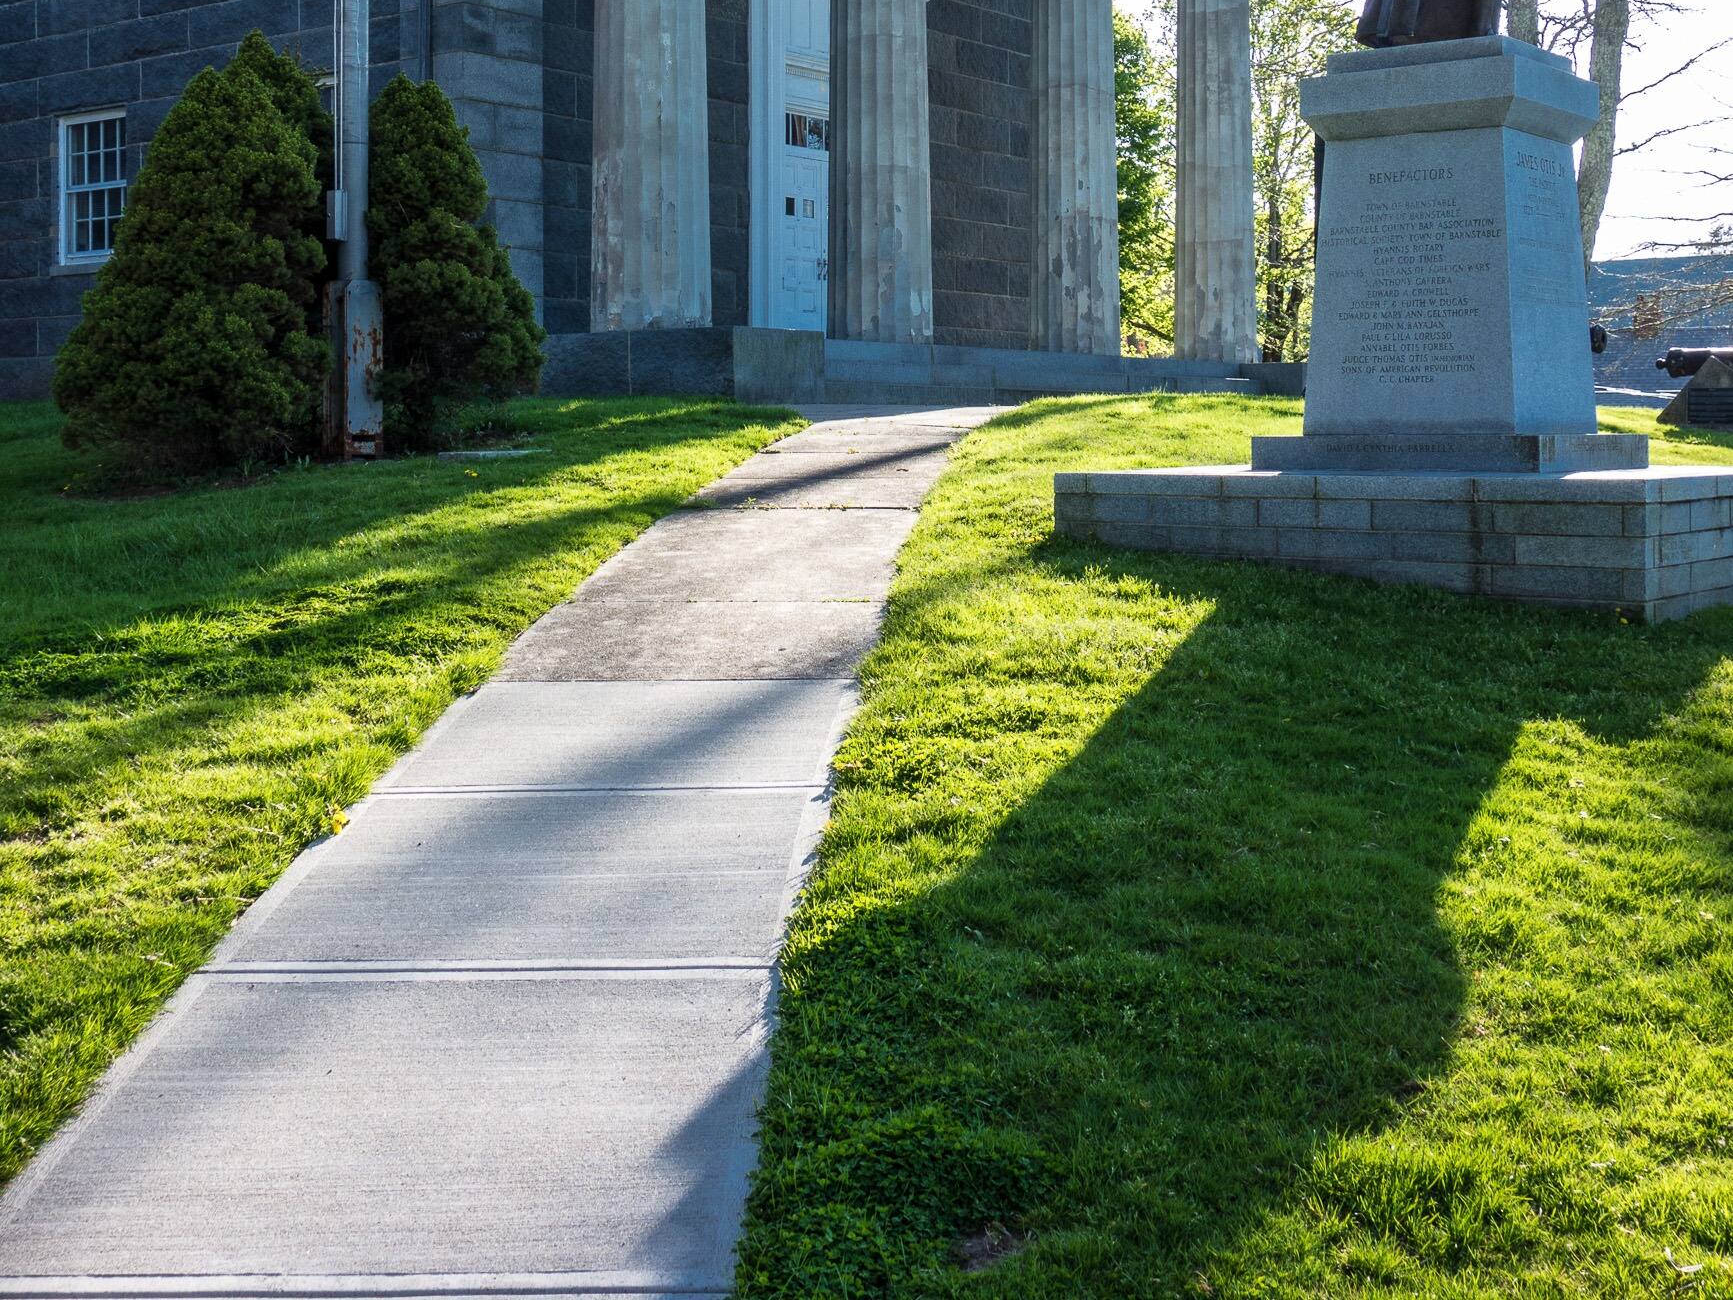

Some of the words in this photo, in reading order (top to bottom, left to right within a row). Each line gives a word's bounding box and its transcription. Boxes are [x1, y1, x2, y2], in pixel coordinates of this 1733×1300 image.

[1516, 151, 1538, 171] JAMES
[1368, 168, 1454, 185] BENEFACTORS
[1365, 203, 1389, 212] TOWN
[1405, 199, 1457, 210] BARNSTABLE
[1409, 209, 1461, 221] BARNSTABLE
[1330, 225, 1379, 236] BARNSTABLE
[1382, 223, 1415, 233] COUNTY
[1437, 218, 1494, 230] ASSOCIATION
[1320, 236, 1369, 248] HISTORICAL
[1409, 233, 1431, 242] TOWN
[1435, 232, 1446, 241] OF
[1449, 228, 1502, 241] BARNSTABLE
[1373, 244, 1409, 255] HYANNIS
[1412, 243, 1444, 253] ROTARY
[1374, 256, 1395, 266] CAPE
[1397, 256, 1415, 265] COD
[1418, 254, 1444, 264] TIMES
[1367, 288, 1400, 299] EDWARD
[1411, 287, 1450, 297] CROWELL
[1350, 300, 1380, 310] JOSEPH
[1439, 297, 1469, 307] DUGAS
[1338, 312, 1370, 321] EDWARD
[1380, 310, 1402, 319] MARY
[1405, 309, 1423, 318] ANN
[1426, 308, 1480, 318] GELSTHORPE
[1371, 321, 1394, 331] JOHN
[1361, 333, 1381, 342] PAUL
[1392, 331, 1411, 341] LILA
[1413, 331, 1453, 341] LORUSSO
[1360, 343, 1398, 352] ANNABEL
[1400, 343, 1420, 352] OTIS
[1422, 342, 1455, 352] FORBES
[1341, 355, 1370, 365] JUDGE
[1372, 354, 1406, 364] THOMAS
[1408, 353, 1429, 363] OTIS
[1340, 365, 1364, 375] SONS
[1365, 365, 1377, 374] OF
[1379, 364, 1422, 374] AMERICAN
[1424, 363, 1477, 373] REVOLUTION
[1397, 374, 1435, 384] CHAPTER
